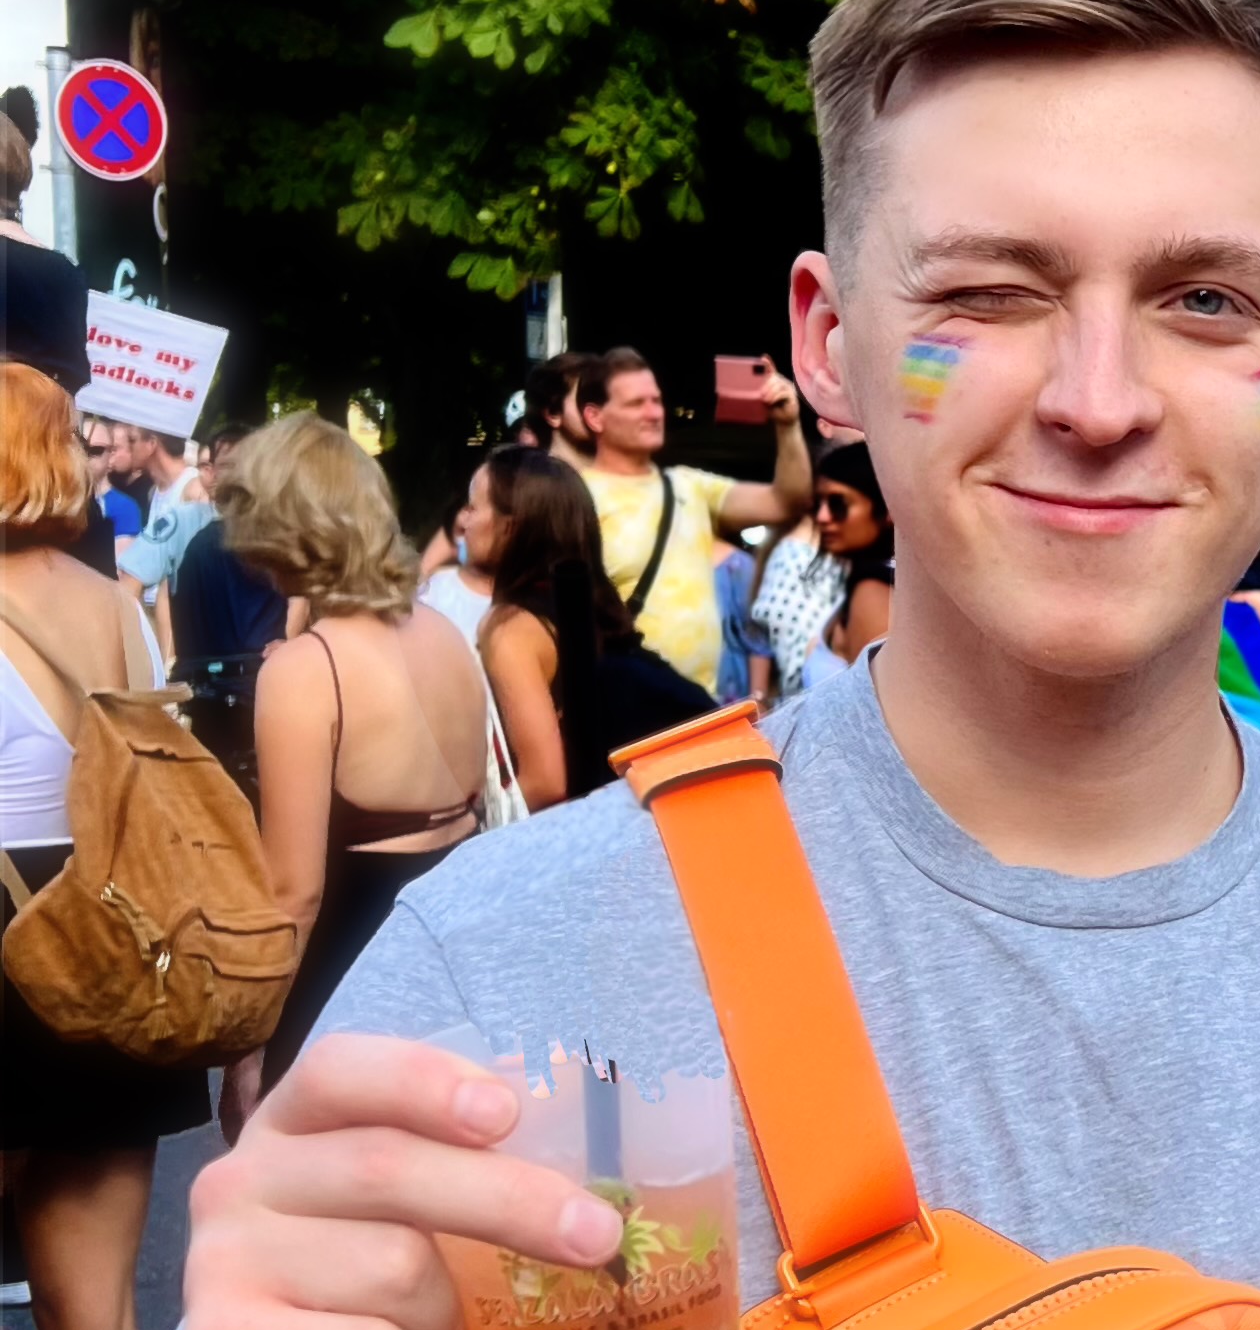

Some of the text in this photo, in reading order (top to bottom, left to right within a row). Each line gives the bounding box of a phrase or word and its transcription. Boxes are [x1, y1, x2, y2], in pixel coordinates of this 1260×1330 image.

[87, 326, 197, 372] love my
[91, 363, 195, 400] adlocks
[627, 1302, 685, 1330] BRASIL
